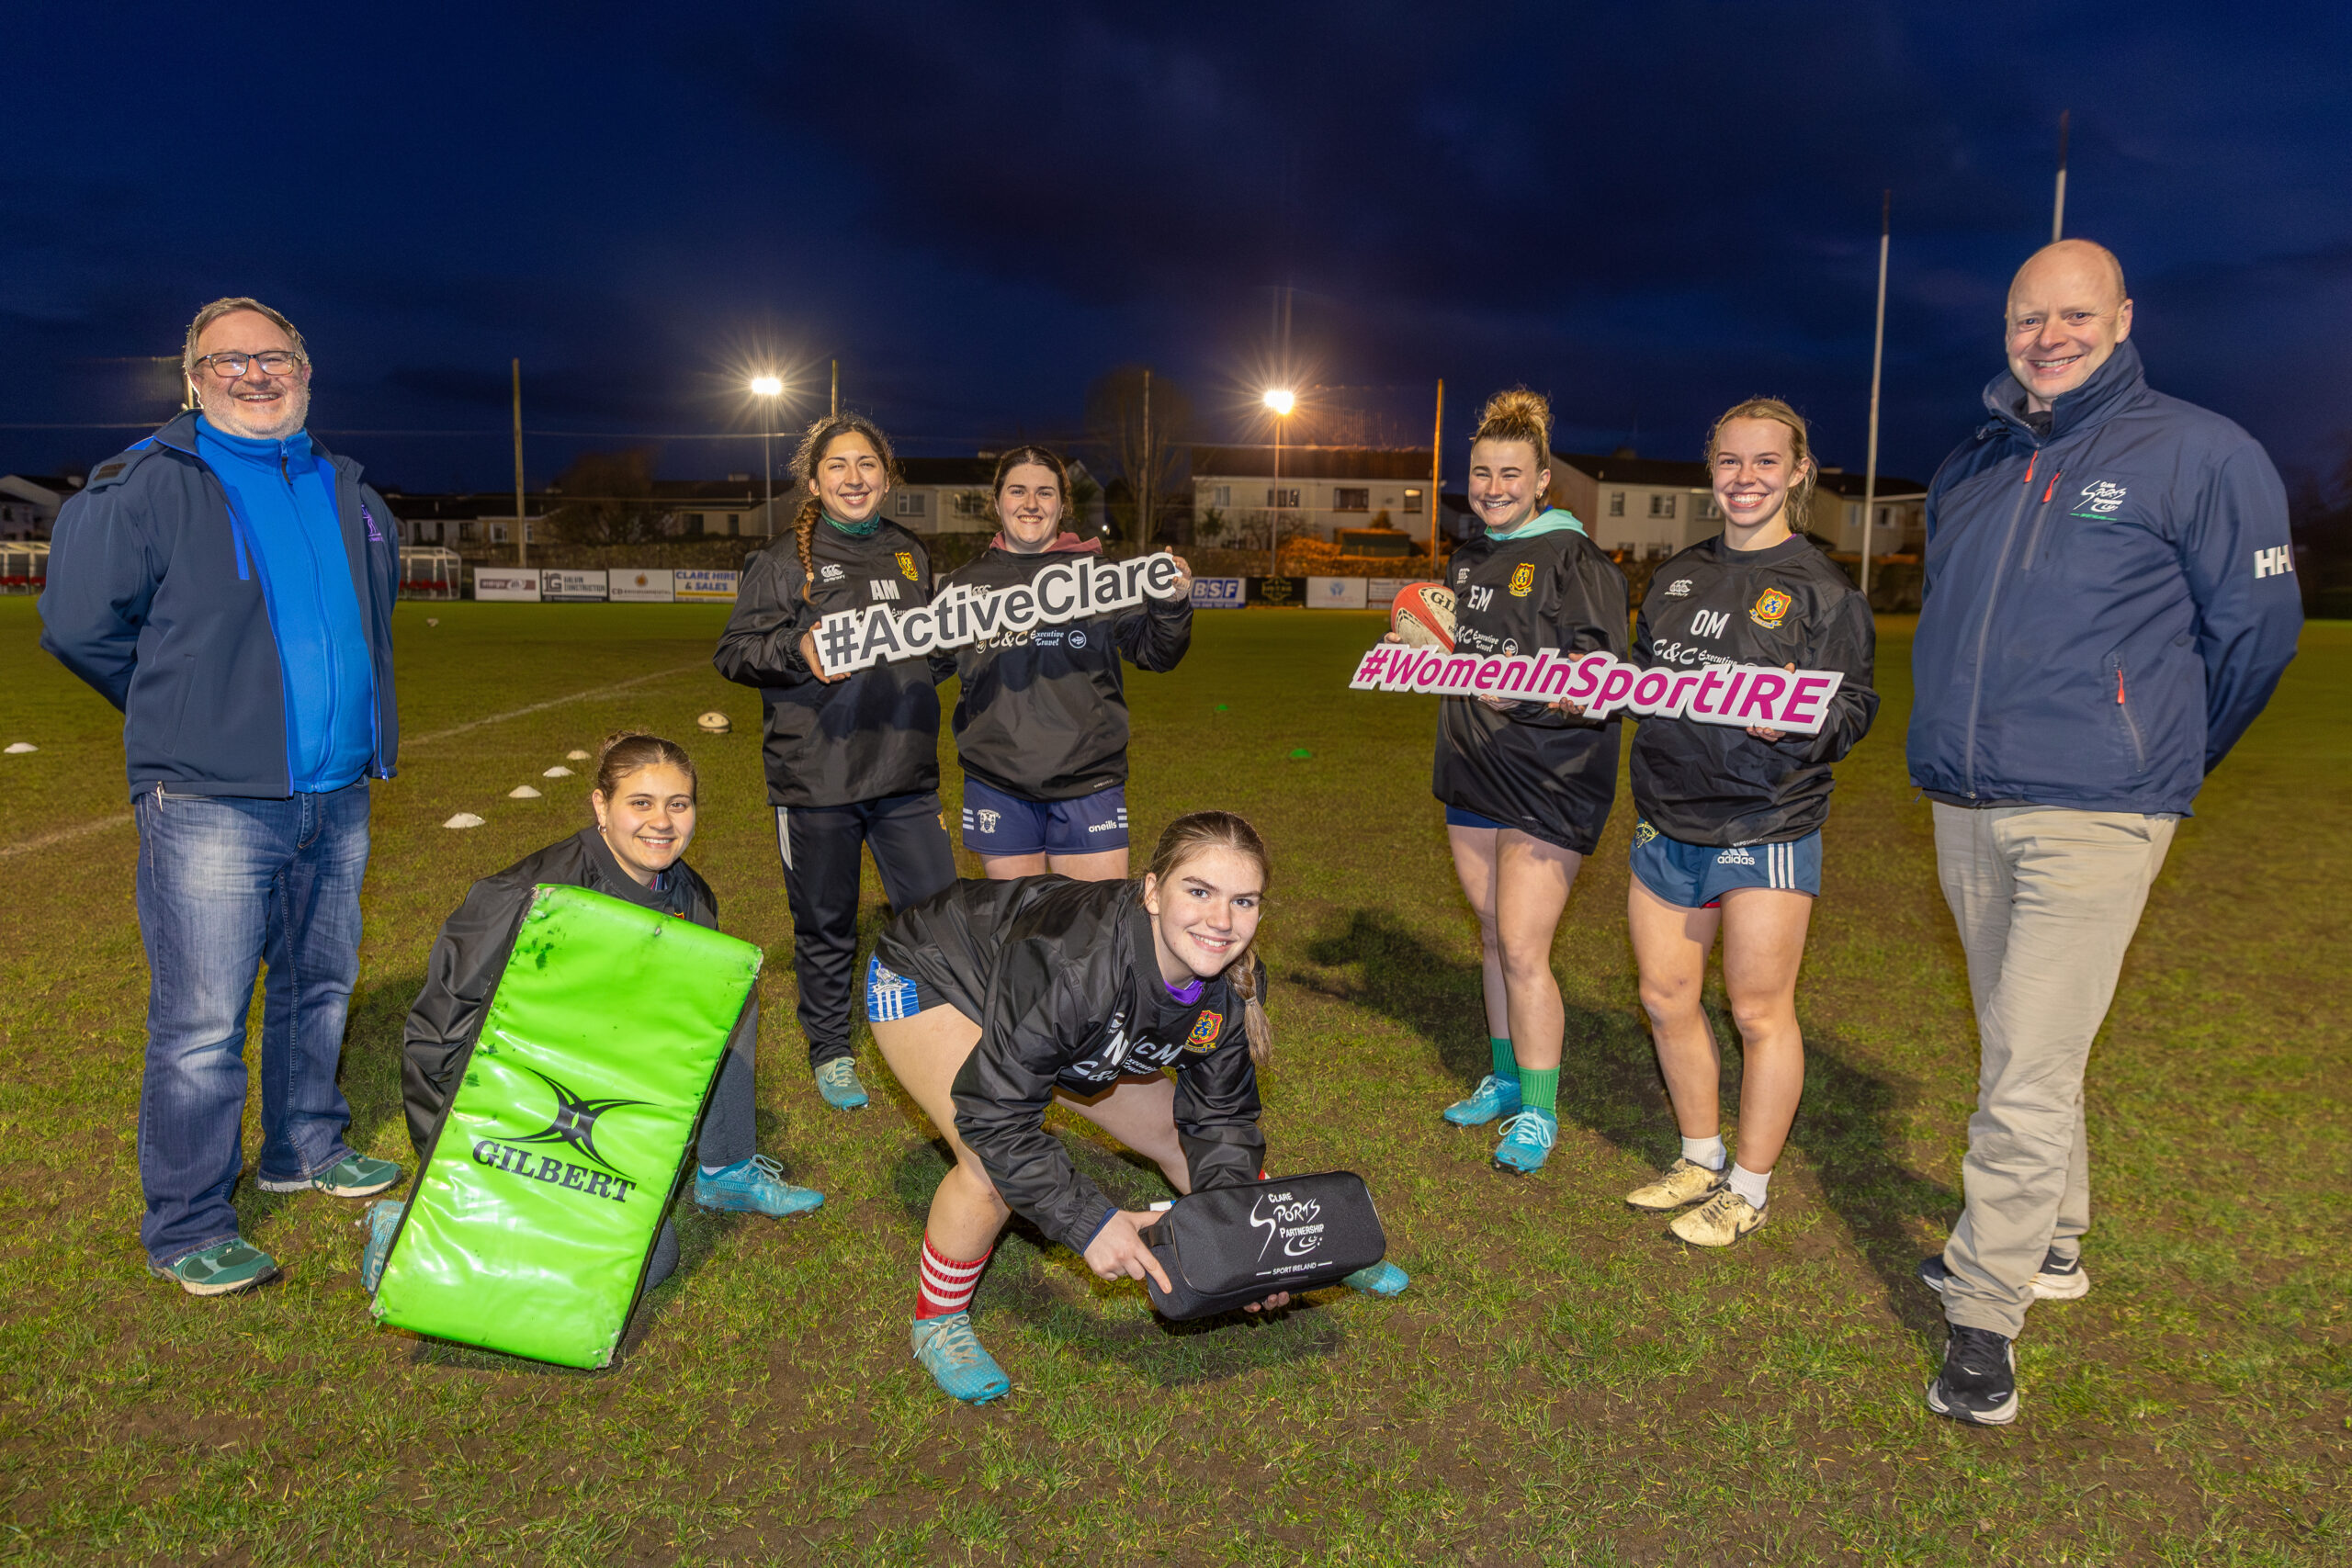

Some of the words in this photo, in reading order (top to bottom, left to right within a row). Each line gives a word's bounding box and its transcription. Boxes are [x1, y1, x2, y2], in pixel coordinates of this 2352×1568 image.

[2254, 544, 2293, 579] HH
[675, 570, 710, 581] CLARE
[711, 572, 736, 581] HIRE
[695, 582, 729, 592] SALES
[869, 580, 900, 601] AM
[1193, 581, 1238, 598] BSF
[1467, 584, 1494, 613] EM
[822, 557, 1176, 668] #ActiveClare
[1690, 609, 1731, 640] OM
[989, 631, 1029, 649] C&C
[1030, 629, 1065, 639] Executive
[1653, 638, 1699, 665] C&C
[1358, 648, 1833, 726] #WomenInSportIRE
[1088, 819, 1117, 833] oneills
[1717, 855, 1756, 865] adidas
[472, 1140, 637, 1203] GILBERT
[1268, 1192, 1294, 1203] CLARE
[1280, 1224, 1325, 1238] PARTNERSHIP
[1272, 1266, 1292, 1275] SPORT
[1293, 1262, 1317, 1272] IRELAND
